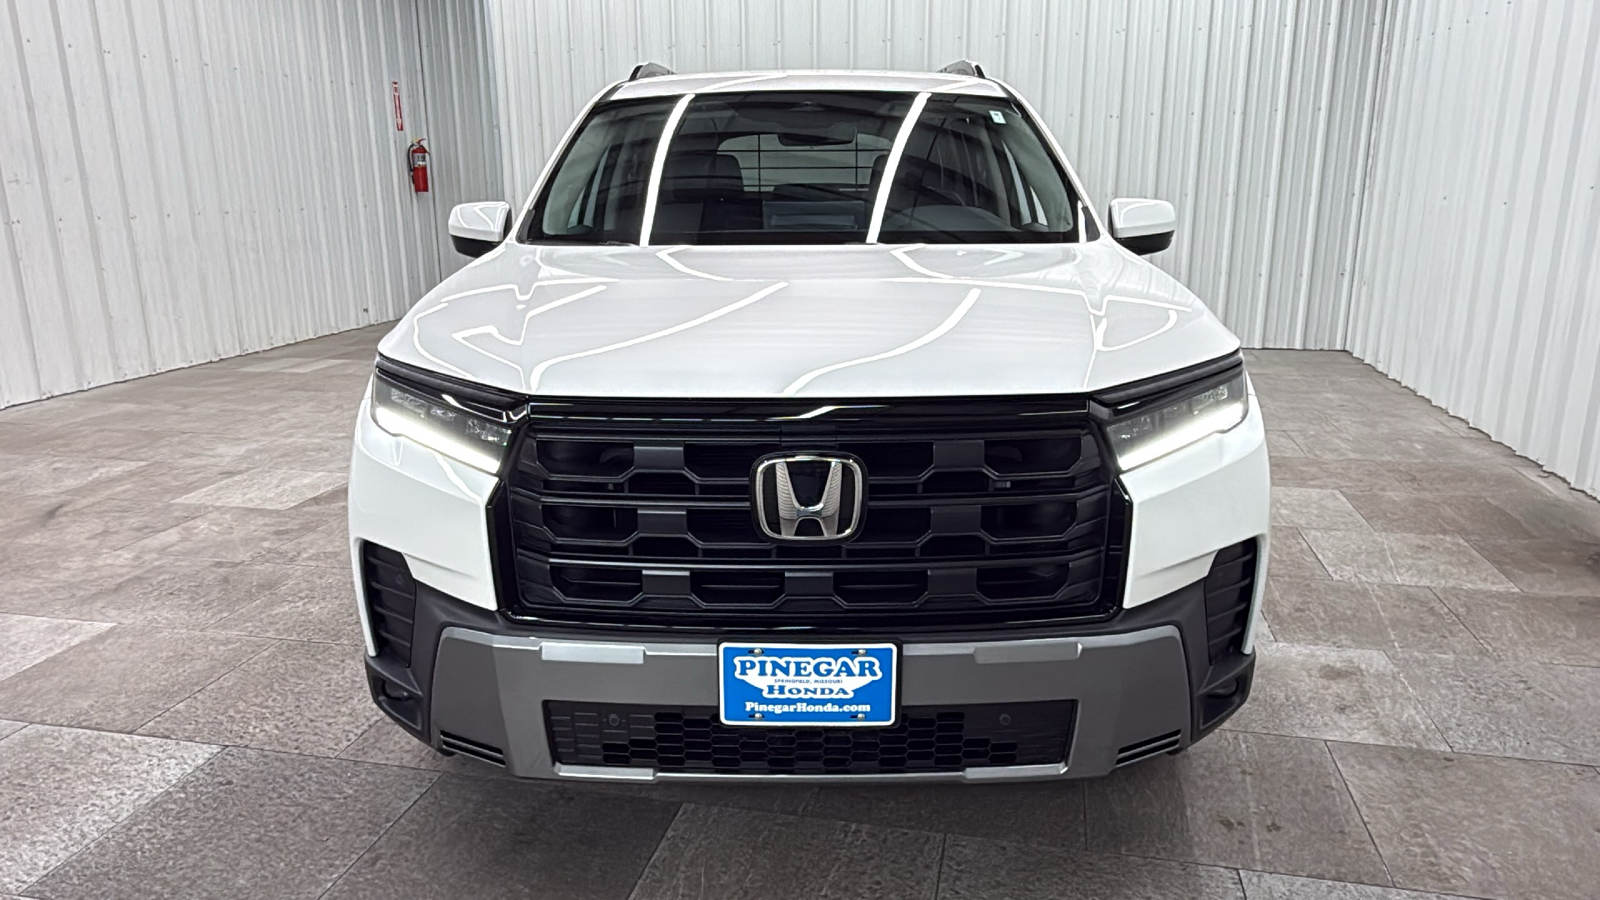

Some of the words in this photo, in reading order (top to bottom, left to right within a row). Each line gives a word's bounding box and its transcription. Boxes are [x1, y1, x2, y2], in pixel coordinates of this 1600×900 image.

[738, 659, 879, 677] PINEGAR
[766, 685, 850, 695] HONDA
[745, 701, 871, 714] PinegarHonda.com
